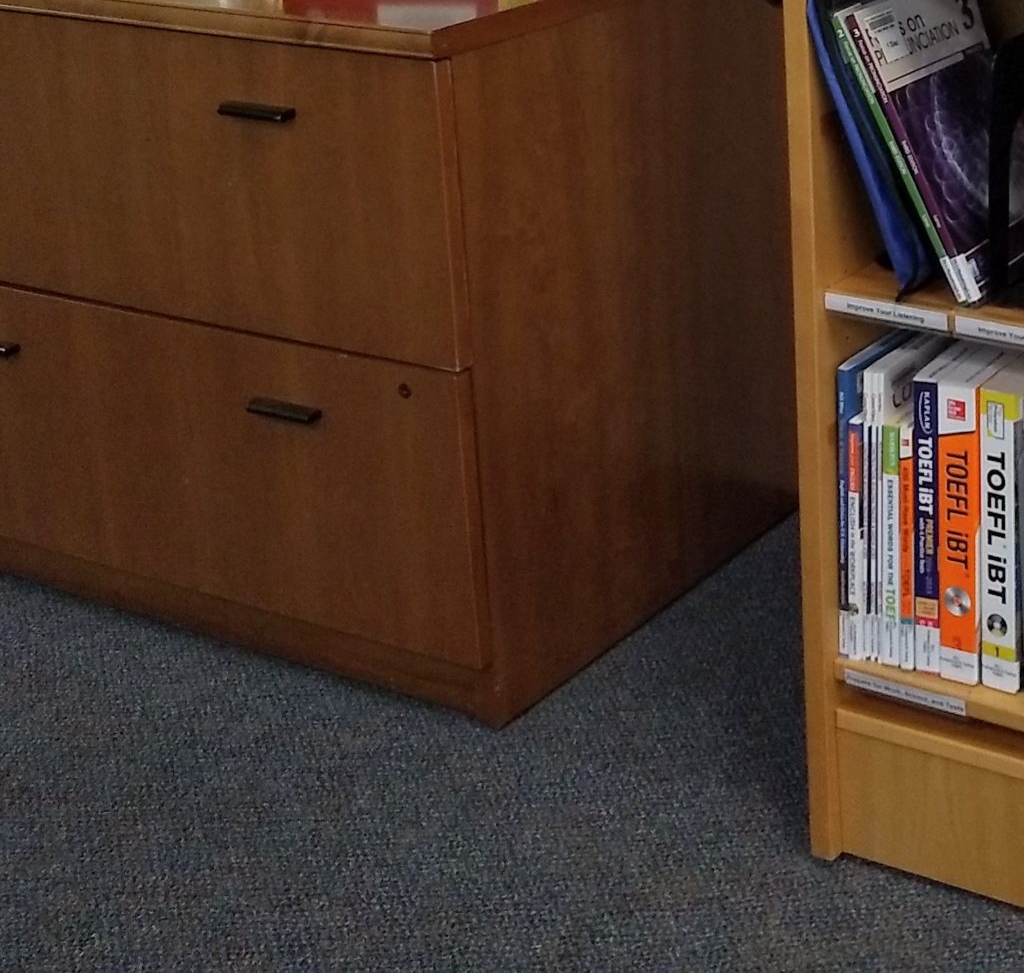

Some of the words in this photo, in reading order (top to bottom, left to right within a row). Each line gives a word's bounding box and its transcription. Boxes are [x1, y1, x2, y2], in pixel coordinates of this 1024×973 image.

[906, 14, 926, 32] on
[846, 302, 875, 315] Improve
[876, 307, 892, 317] Your
[893, 310, 925, 324] Listening
[978, 326, 1007, 339] Improve
[922, 391, 931, 431] KAPLAN
[918, 437, 933, 485] TOEFL
[918, 488, 934, 515] iBT
[945, 450, 969, 521] TOEFL
[986, 451, 1006, 546] TOEFL
[946, 529, 969, 570] iBT
[987, 554, 1007, 604] iBT
